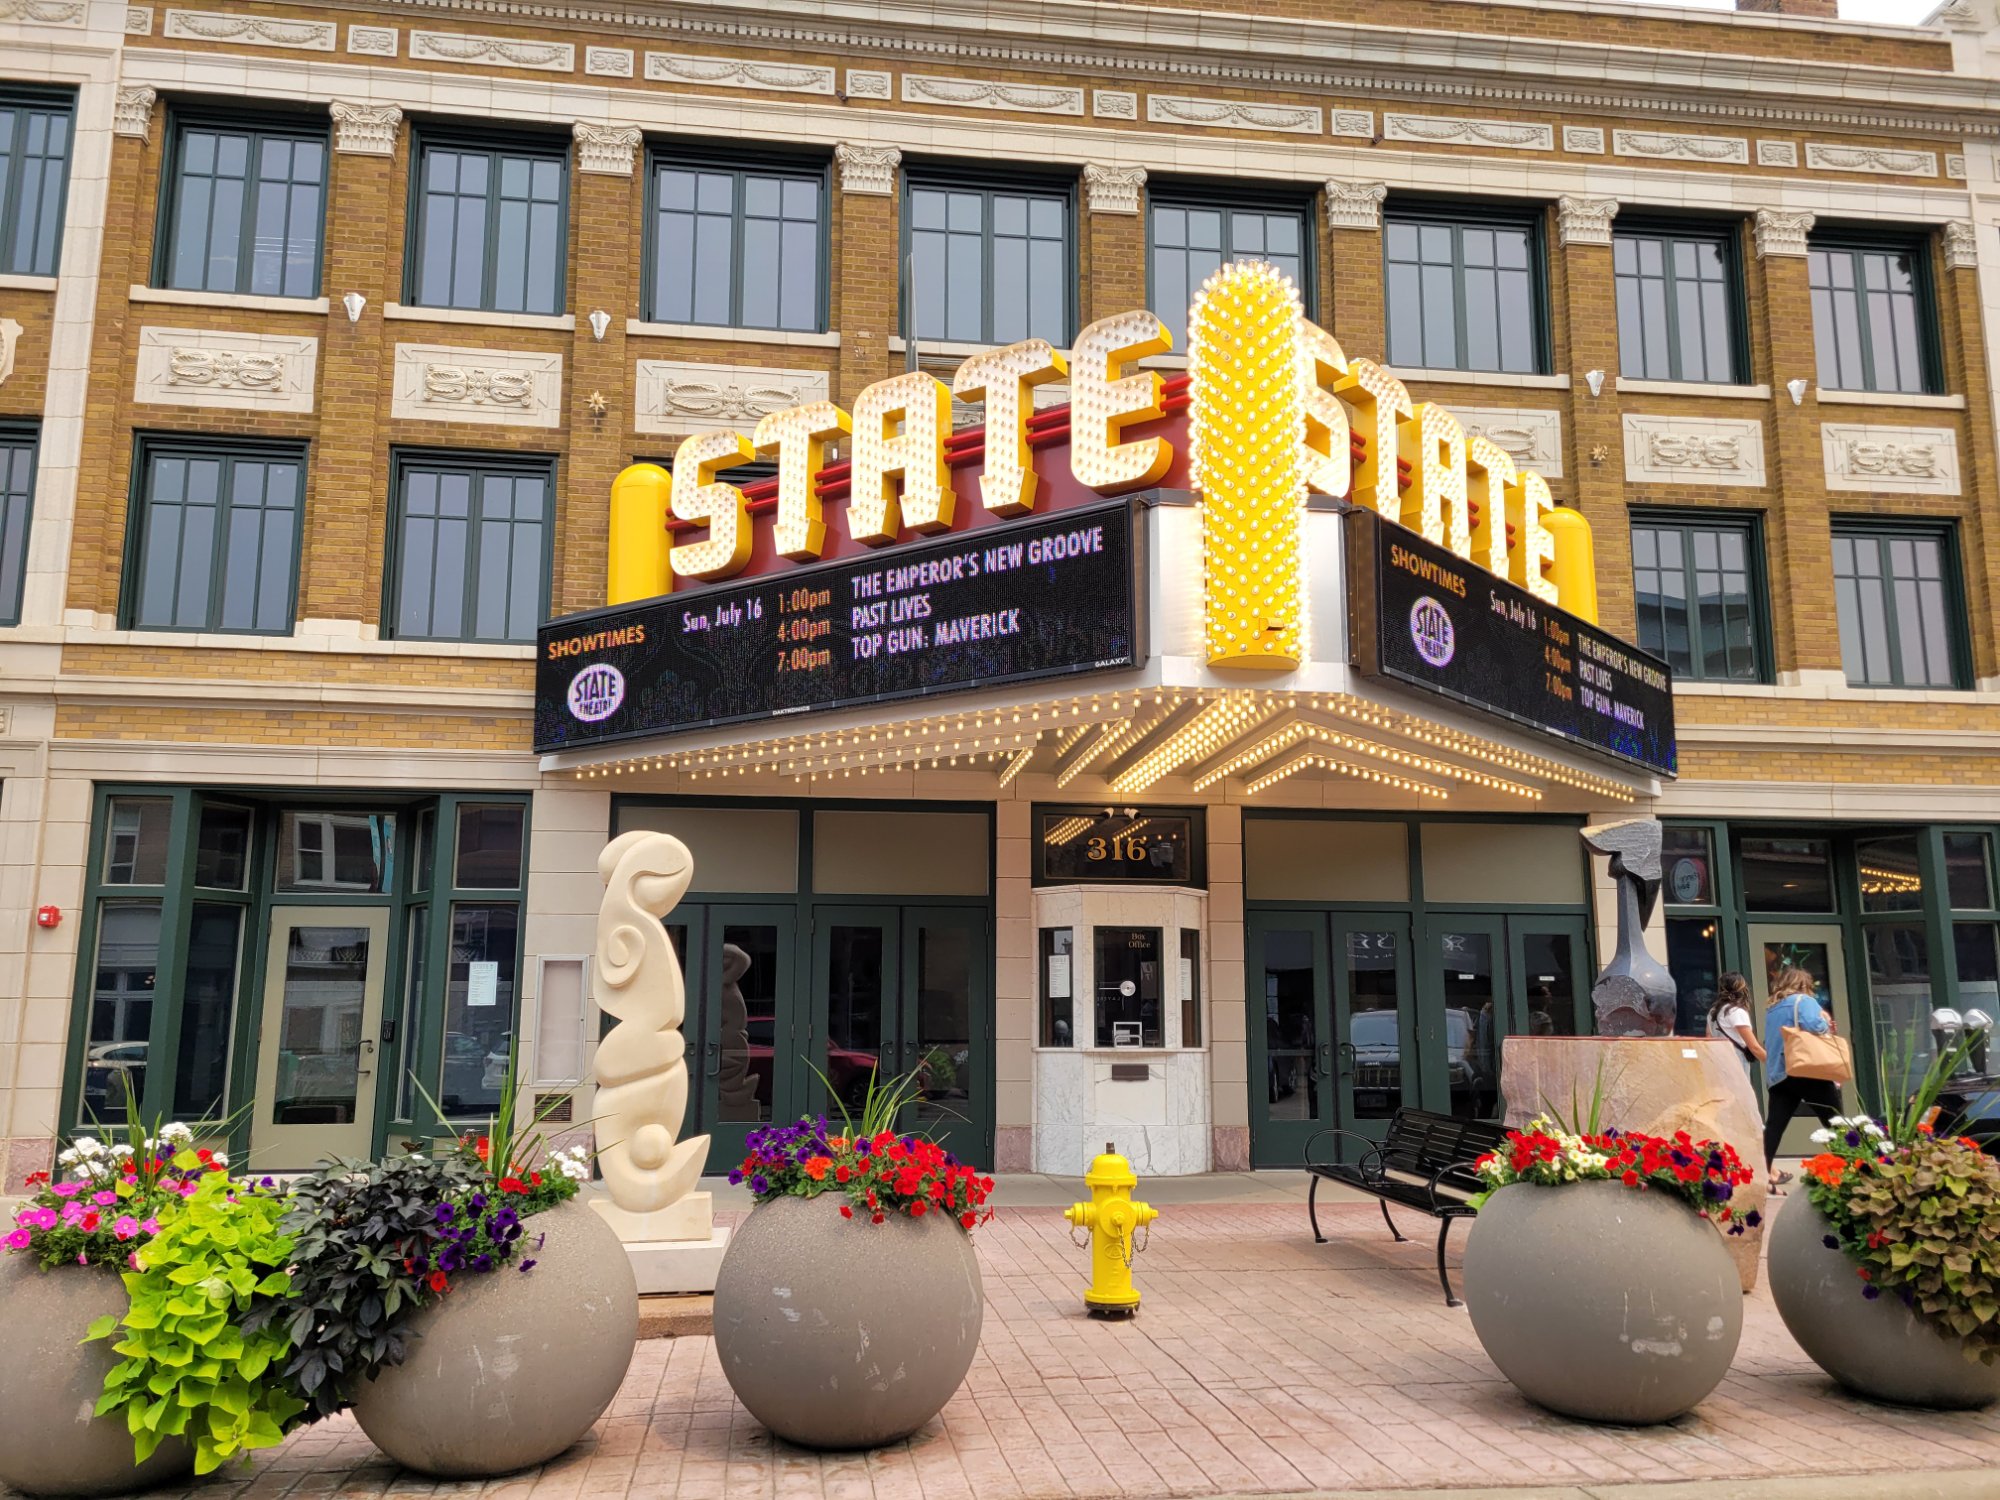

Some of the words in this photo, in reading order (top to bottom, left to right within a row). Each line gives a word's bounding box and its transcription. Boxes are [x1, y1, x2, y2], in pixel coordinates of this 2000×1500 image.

[669, 310, 1173, 582] STATE
[1298, 318, 1559, 606] STATE
[851, 571, 881, 599] THE
[886, 553, 980, 593] EMPEROR'S
[984, 543, 1023, 574] NEW
[1028, 527, 1103, 565] GROOVE
[1391, 545, 1466, 598] SHOWTIMES
[682, 612, 711, 633] Sun,
[716, 604, 741, 627] July
[746, 598, 762, 620] 16
[778, 587, 831, 613] 1:00pm
[851, 601, 887, 630] PAST
[891, 593, 931, 622] LIVES
[1510, 599, 1525, 628] July
[1527, 606, 1536, 630] 16
[547, 624, 646, 660] SHOWTIMES
[777, 618, 831, 643] 4:00pm
[851, 634, 882, 660] TOP
[887, 626, 929, 655] GUN:
[934, 608, 1020, 646] MAVERICK
[1416, 604, 1449, 645] STATE
[777, 647, 831, 672] 7:00pm
[1095, 657, 1125, 668] GALAXY
[1577, 632, 1592, 657] THE
[1629, 658, 1643, 681] NEW
[574, 670, 616, 702] STATE
[1579, 659, 1595, 684] PAST
[1595, 666, 1613, 692] LIVES
[1580, 685, 1593, 709] TOP
[1614, 699, 1645, 730] MAVERICK
[1087, 837, 1147, 862] 316
[1128, 940, 1151, 949] Office
[1131, 932, 1146, 940] Box
